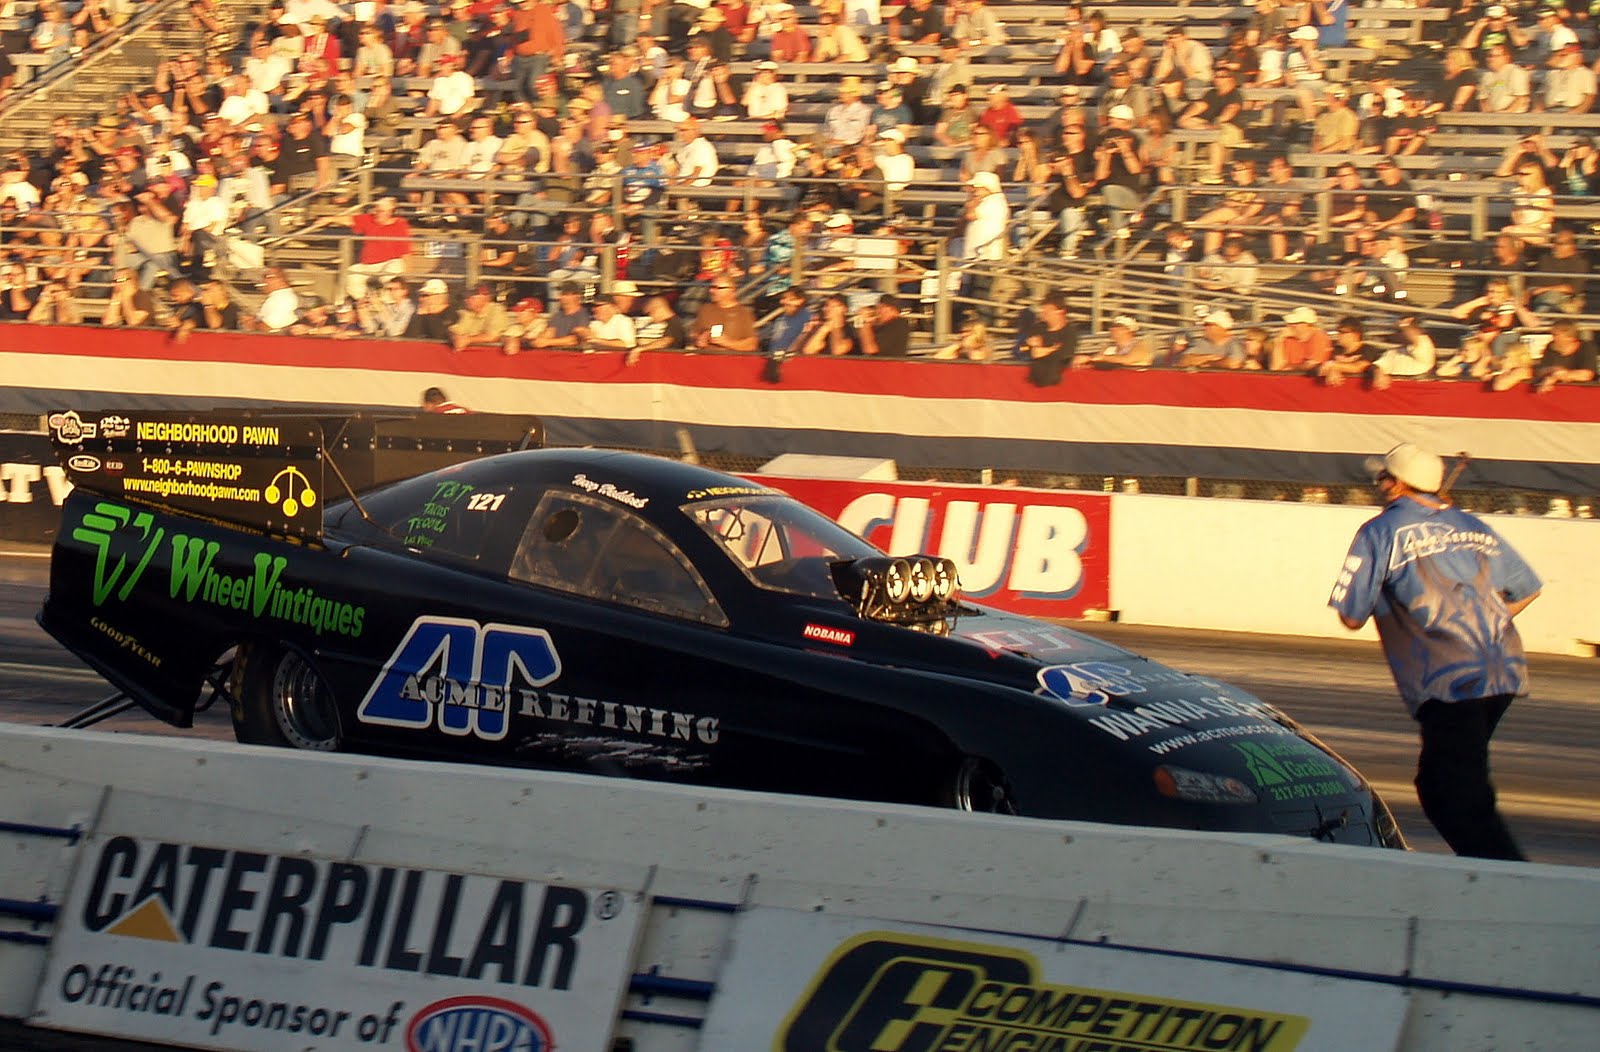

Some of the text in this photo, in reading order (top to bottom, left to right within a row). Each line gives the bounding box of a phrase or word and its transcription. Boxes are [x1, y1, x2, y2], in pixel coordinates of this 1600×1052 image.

[136, 421, 238, 445] NEIGHBORHOOD
[243, 426, 279, 446] PAWN
[123, 477, 260, 502] www.neighborhoodpawn.com
[142, 458, 242, 481] 1-800-6-PAWNSHOP
[466, 493, 506, 512] 121
[90, 616, 161, 668] GOODYEAR
[804, 625, 853, 645] NOBAMA
[398, 671, 720, 745] ACME REFINING
[1088, 697, 1220, 741] WANNA
[83, 834, 588, 991] CATERPILLAR
[61, 963, 404, 1043] Official Sponsor of
[966, 982, 1284, 1050] COMPETITION
